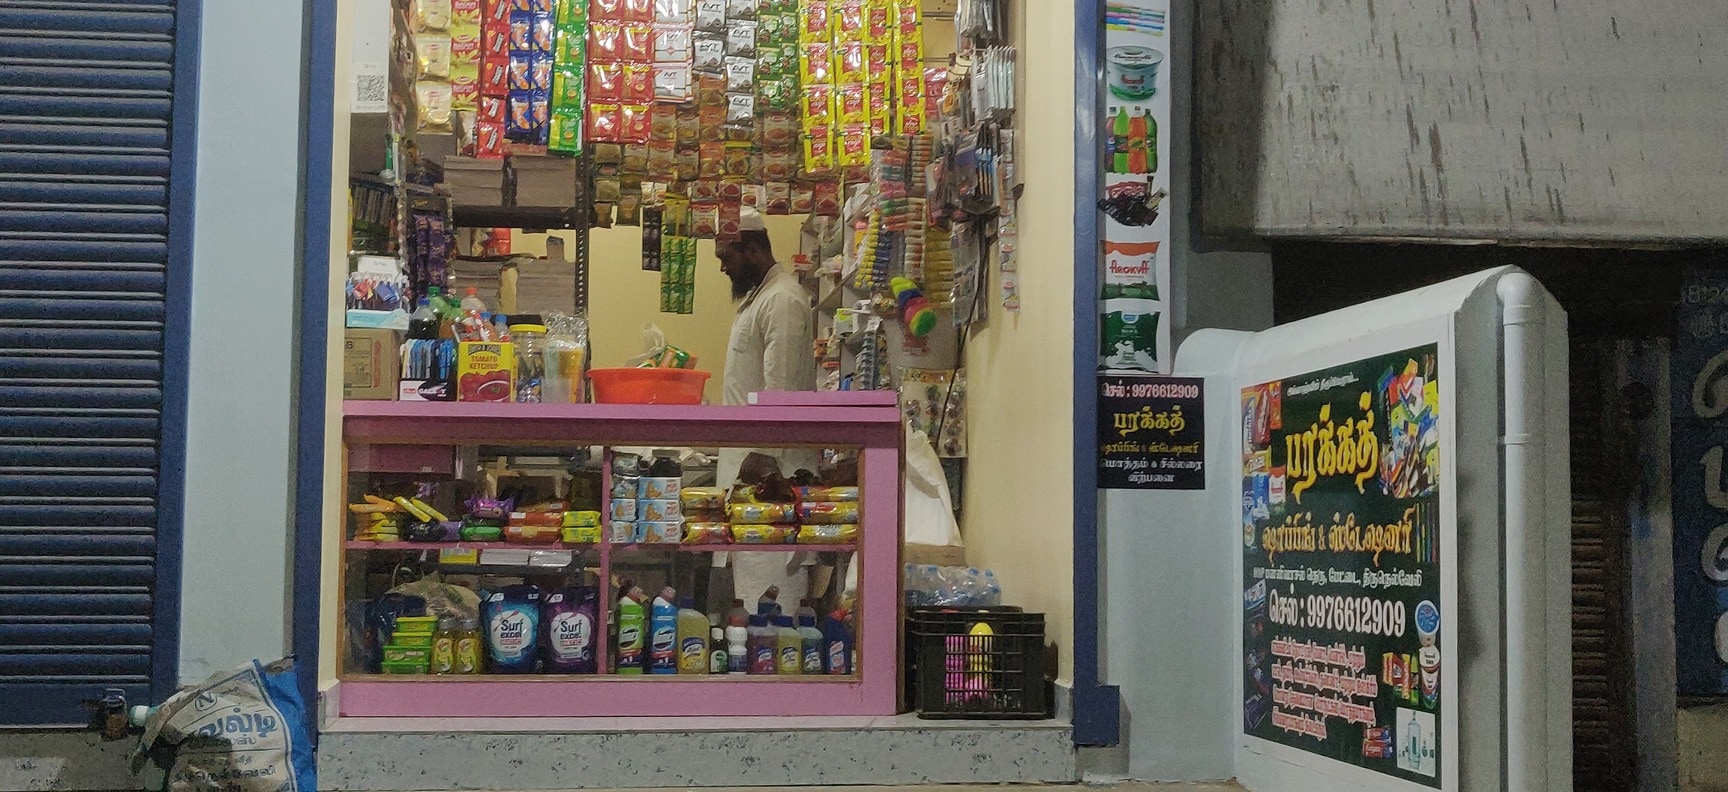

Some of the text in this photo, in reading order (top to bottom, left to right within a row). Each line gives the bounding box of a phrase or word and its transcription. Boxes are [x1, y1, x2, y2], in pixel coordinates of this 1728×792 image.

[1132, 384, 1199, 398] 9976612909
[1113, 404, 1186, 437] பரக்கத்
[1285, 389, 1378, 505] பரக்கத்
[1318, 525, 1326, 551] &
[1328, 505, 1417, 567] ஸ்டேஷனரி
[1362, 567, 1423, 589] திருநெல்வேலி
[1269, 583, 1299, 626] செல்
[1307, 594, 1406, 637] 9976612909
[501, 618, 524, 632] Surf
[560, 619, 583, 633] Surf
